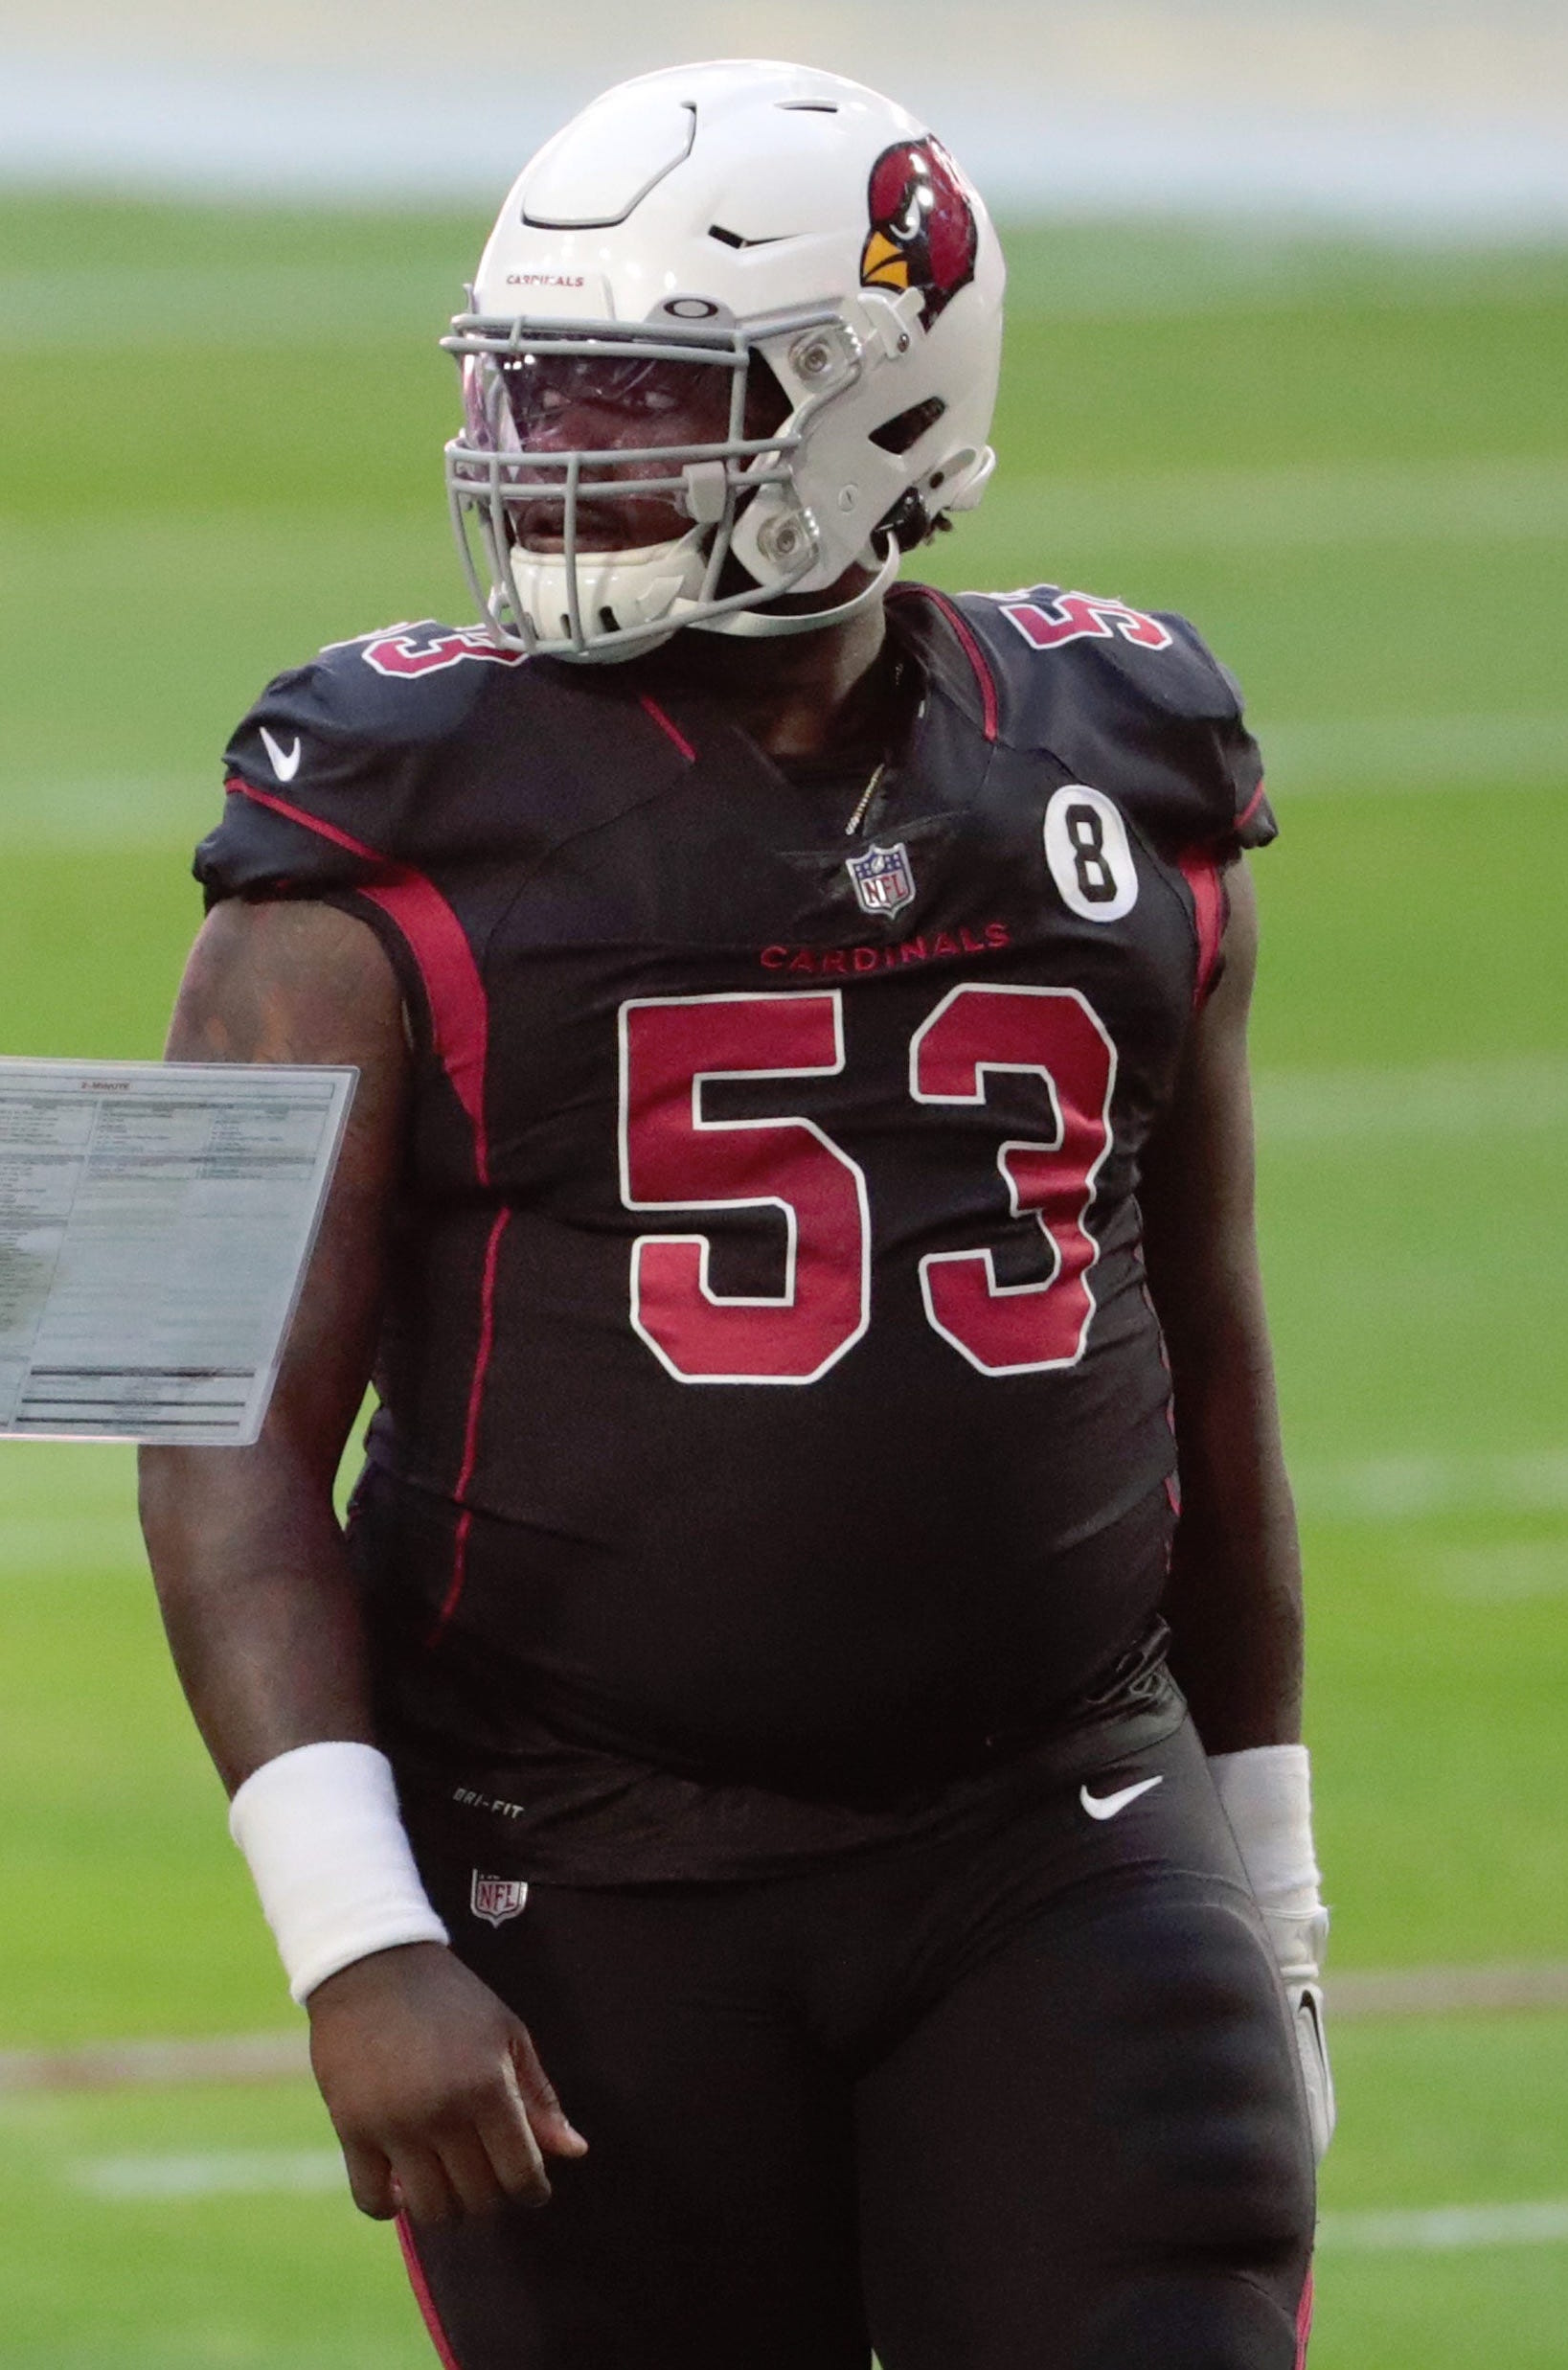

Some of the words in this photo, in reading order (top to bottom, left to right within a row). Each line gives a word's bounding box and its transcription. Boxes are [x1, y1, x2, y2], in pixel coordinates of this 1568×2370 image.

[1065, 804, 1117, 902] 8
[863, 873, 907, 904] NFL
[761, 923, 1010, 973] CARDINALS
[618, 983, 1118, 1384] 53
[453, 1788, 524, 1818] DRI-FIT
[480, 1883, 514, 1910] NFL
